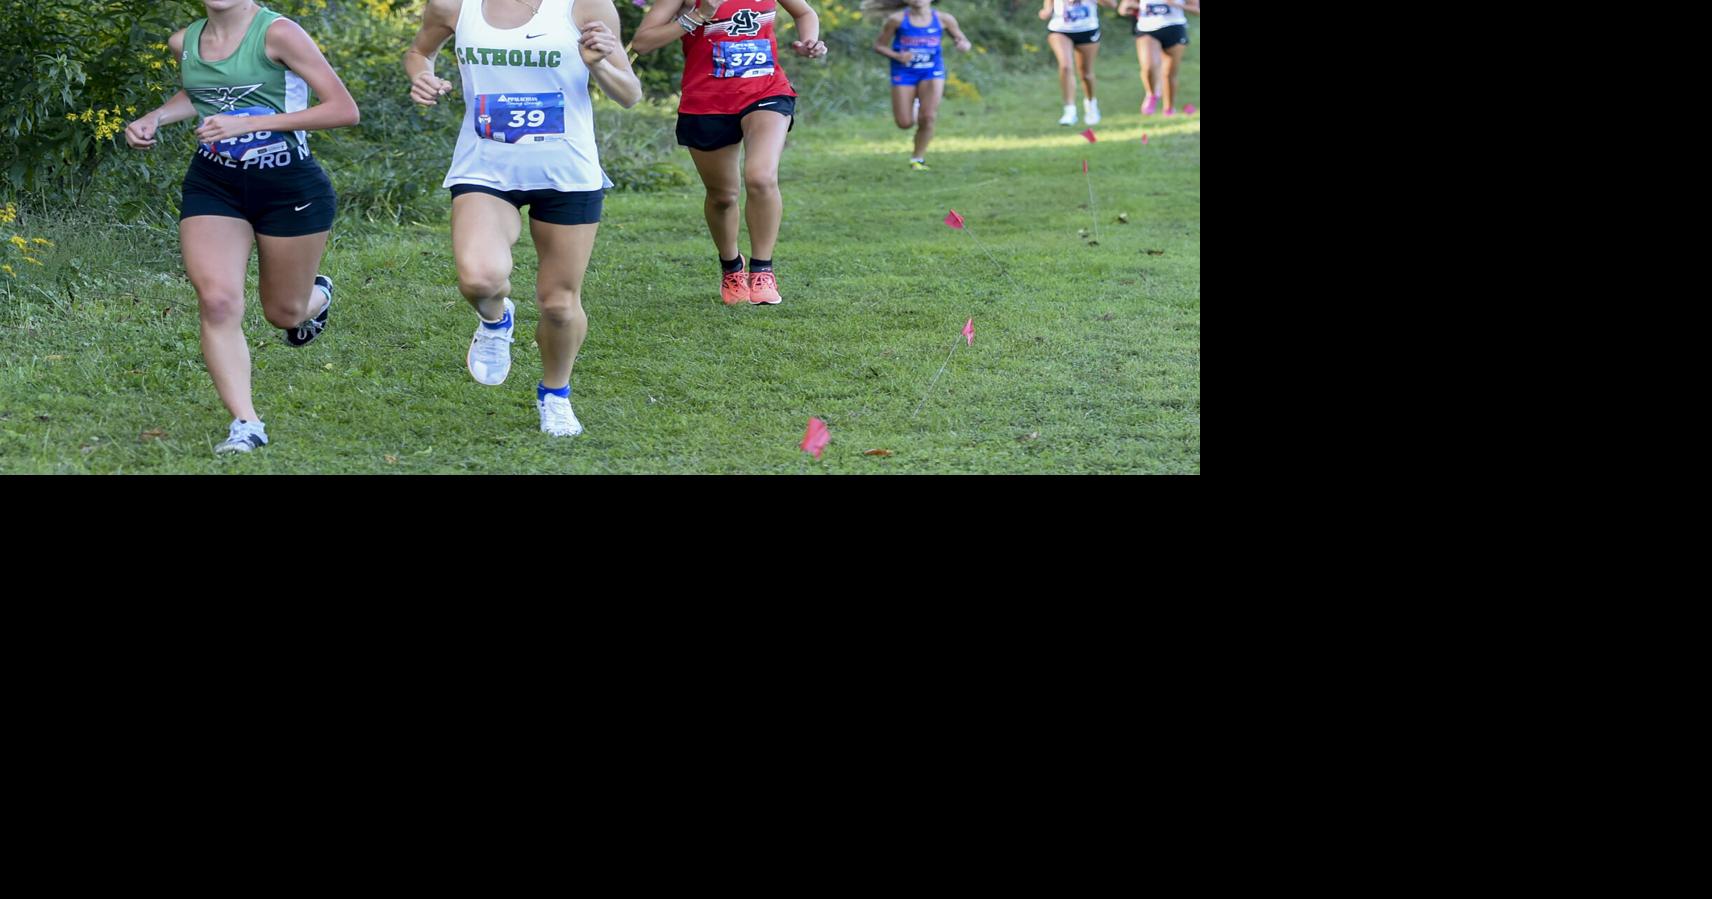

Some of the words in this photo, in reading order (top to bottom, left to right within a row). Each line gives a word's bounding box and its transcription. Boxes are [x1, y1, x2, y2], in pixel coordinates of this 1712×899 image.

[456, 47, 562, 68] CATHOLIC
[731, 52, 767, 67] 379
[507, 109, 545, 128] 39
[242, 151, 292, 170] PRO
